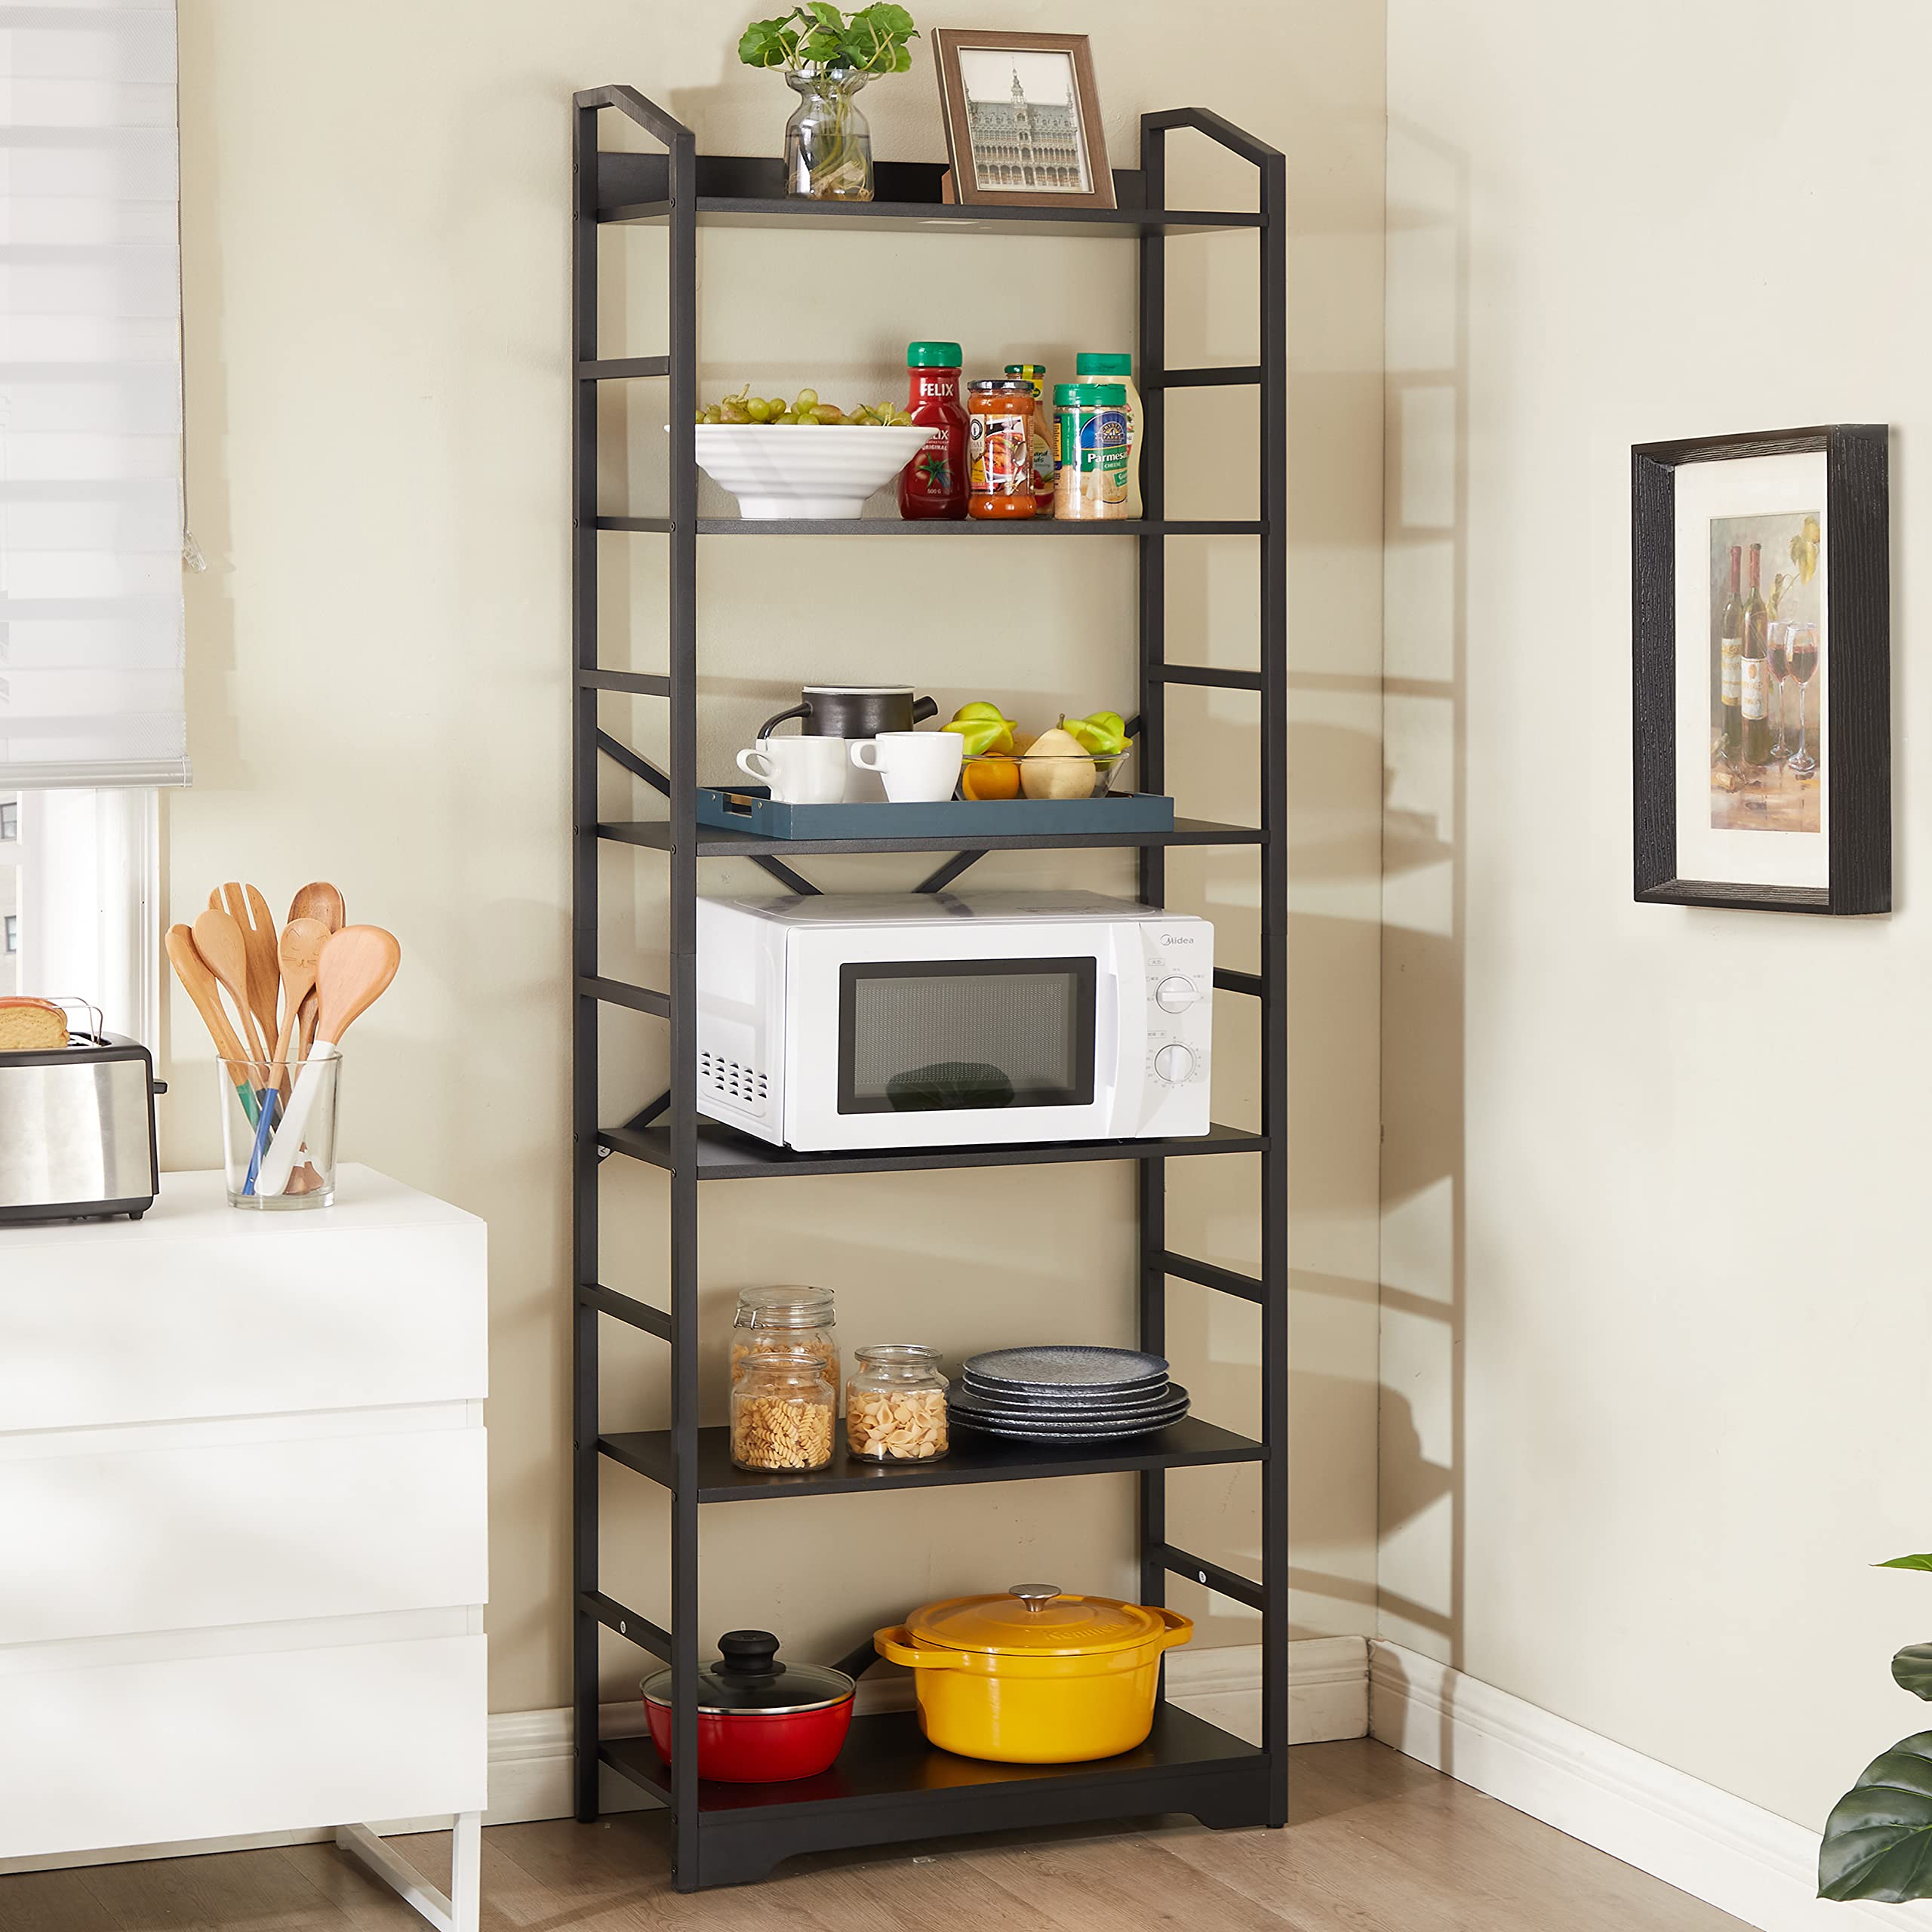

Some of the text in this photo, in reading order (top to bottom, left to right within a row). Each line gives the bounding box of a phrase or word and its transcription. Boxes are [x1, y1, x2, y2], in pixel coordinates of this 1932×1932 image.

[920, 383, 954, 397] FELIX
[1088, 451, 1128, 463] Parmesa
[1160, 934, 1194, 946] Midea
